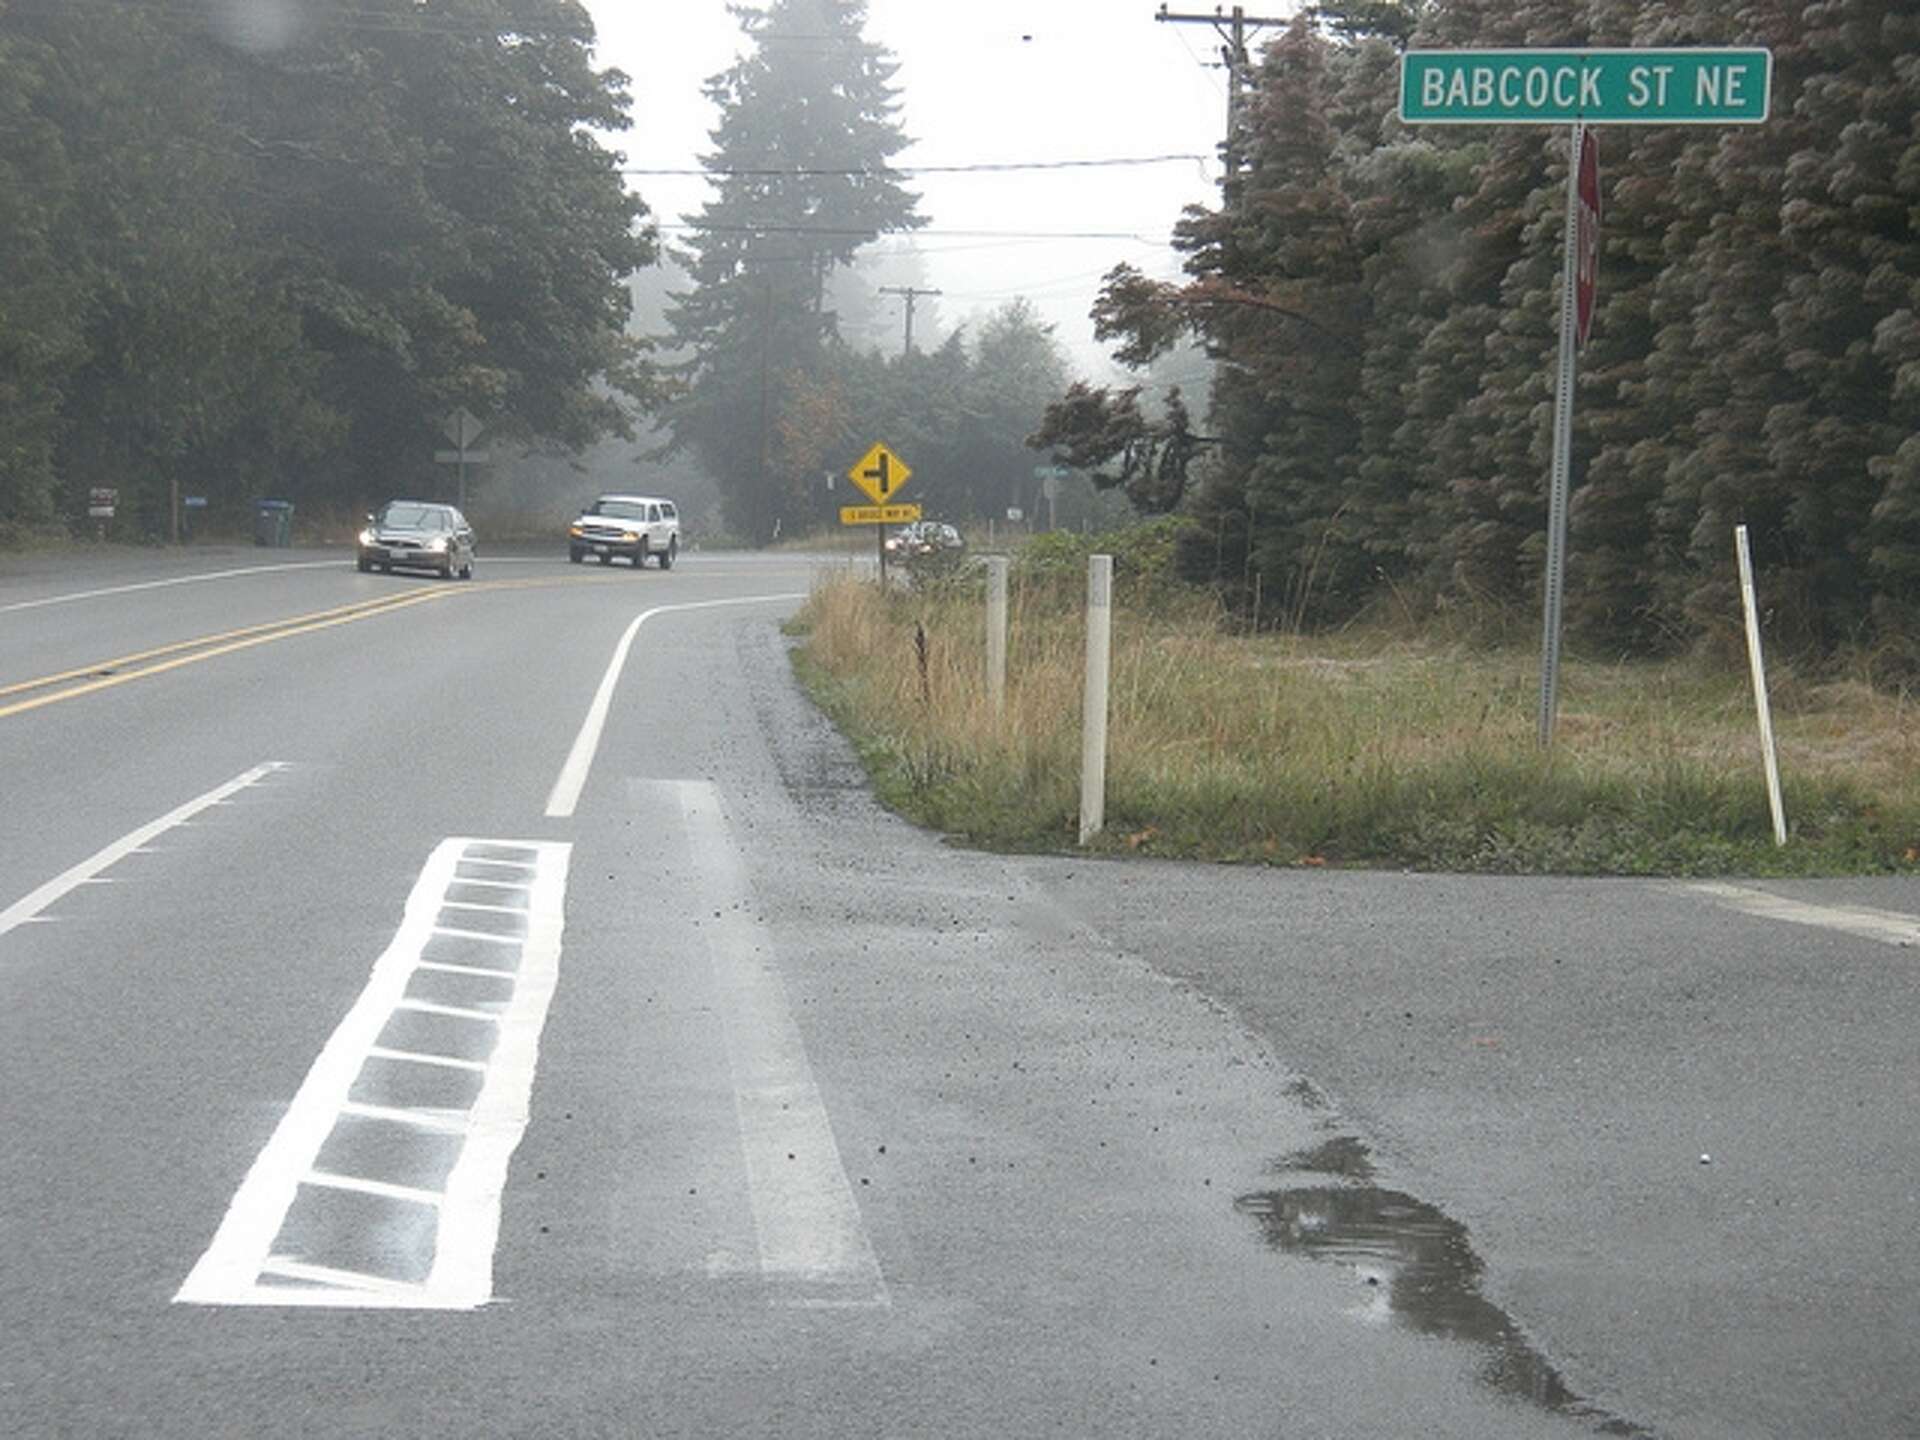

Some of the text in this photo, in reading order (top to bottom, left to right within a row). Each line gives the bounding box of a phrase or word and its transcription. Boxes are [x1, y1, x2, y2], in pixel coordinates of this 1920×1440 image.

[1422, 66, 1747, 107] BABCOCK ST NE
